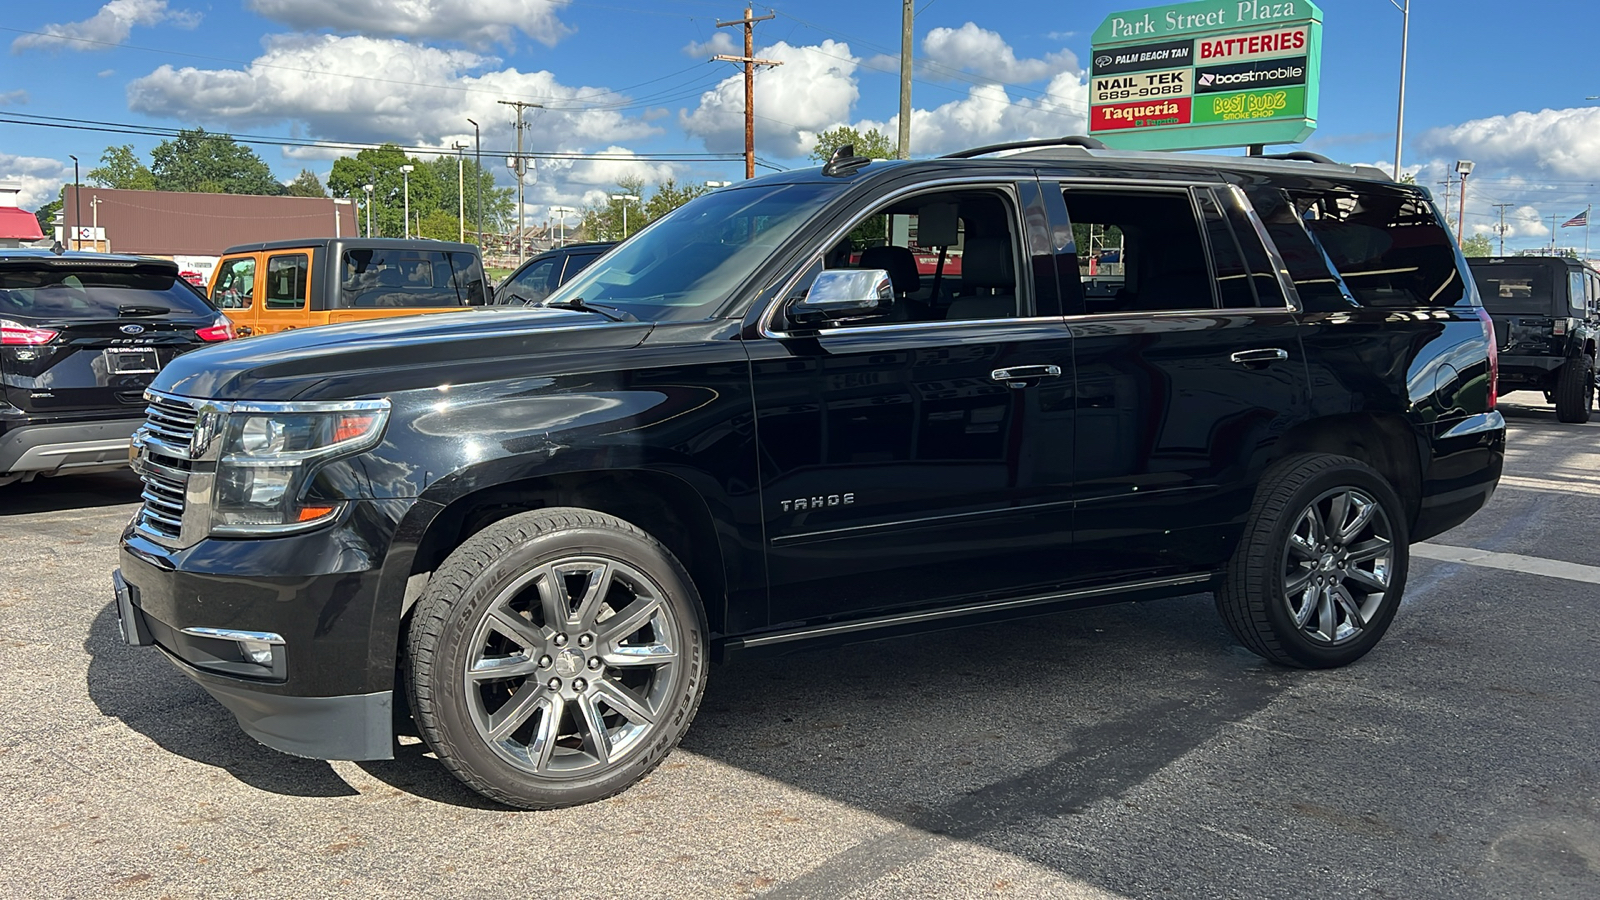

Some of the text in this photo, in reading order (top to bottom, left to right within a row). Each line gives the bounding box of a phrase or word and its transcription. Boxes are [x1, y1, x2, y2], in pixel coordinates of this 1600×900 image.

[1111, 0, 1295, 38] Park Street Plaza
[1200, 30, 1305, 59] BATTERIES
[1115, 47, 1189, 65] PALM BEACH TAN
[1097, 71, 1185, 91] NAIL TEK
[1098, 84, 1183, 101] 689-9088
[1223, 110, 1274, 120] SMOKE SHOP
[780, 492, 854, 512] TAHOE
[672, 629, 699, 727] DUELER
